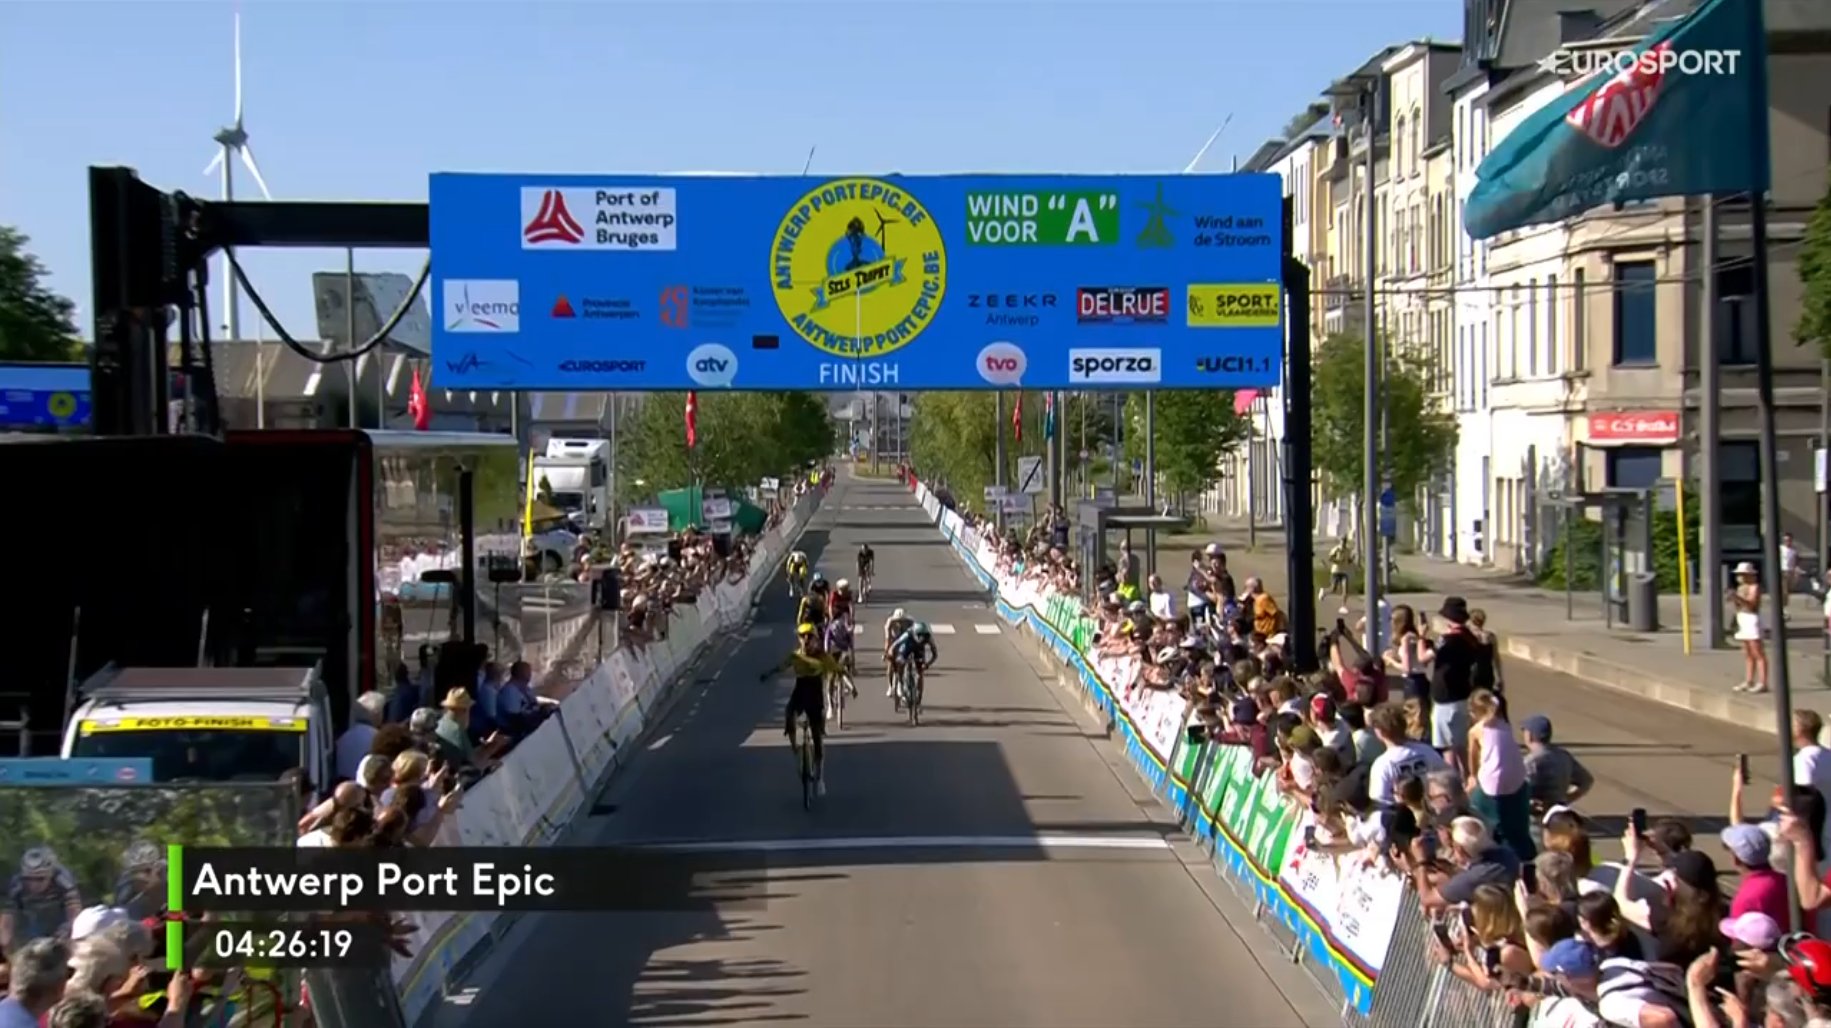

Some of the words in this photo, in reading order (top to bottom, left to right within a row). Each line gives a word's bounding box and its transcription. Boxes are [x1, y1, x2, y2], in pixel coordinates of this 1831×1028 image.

[595, 191, 634, 206] Port
[640, 191, 660, 206] of
[967, 194, 1039, 217] WIND
[595, 209, 675, 229] Antwerp
[1194, 215, 1233, 229] Wind
[1236, 217, 1264, 229] aan
[595, 228, 660, 249] Bruges
[967, 221, 1038, 243] VOOR
[1193, 232, 1213, 247] de
[1214, 232, 1272, 247] Stroom
[967, 293, 1058, 308] ZEEKR
[1081, 292, 1166, 316] DELRUE
[985, 313, 1040, 328] Antwerp
[560, 359, 647, 373] EUROSPORT
[695, 356, 729, 373] atv
[985, 356, 1018, 372] tvo
[819, 362, 899, 384] FINISH
